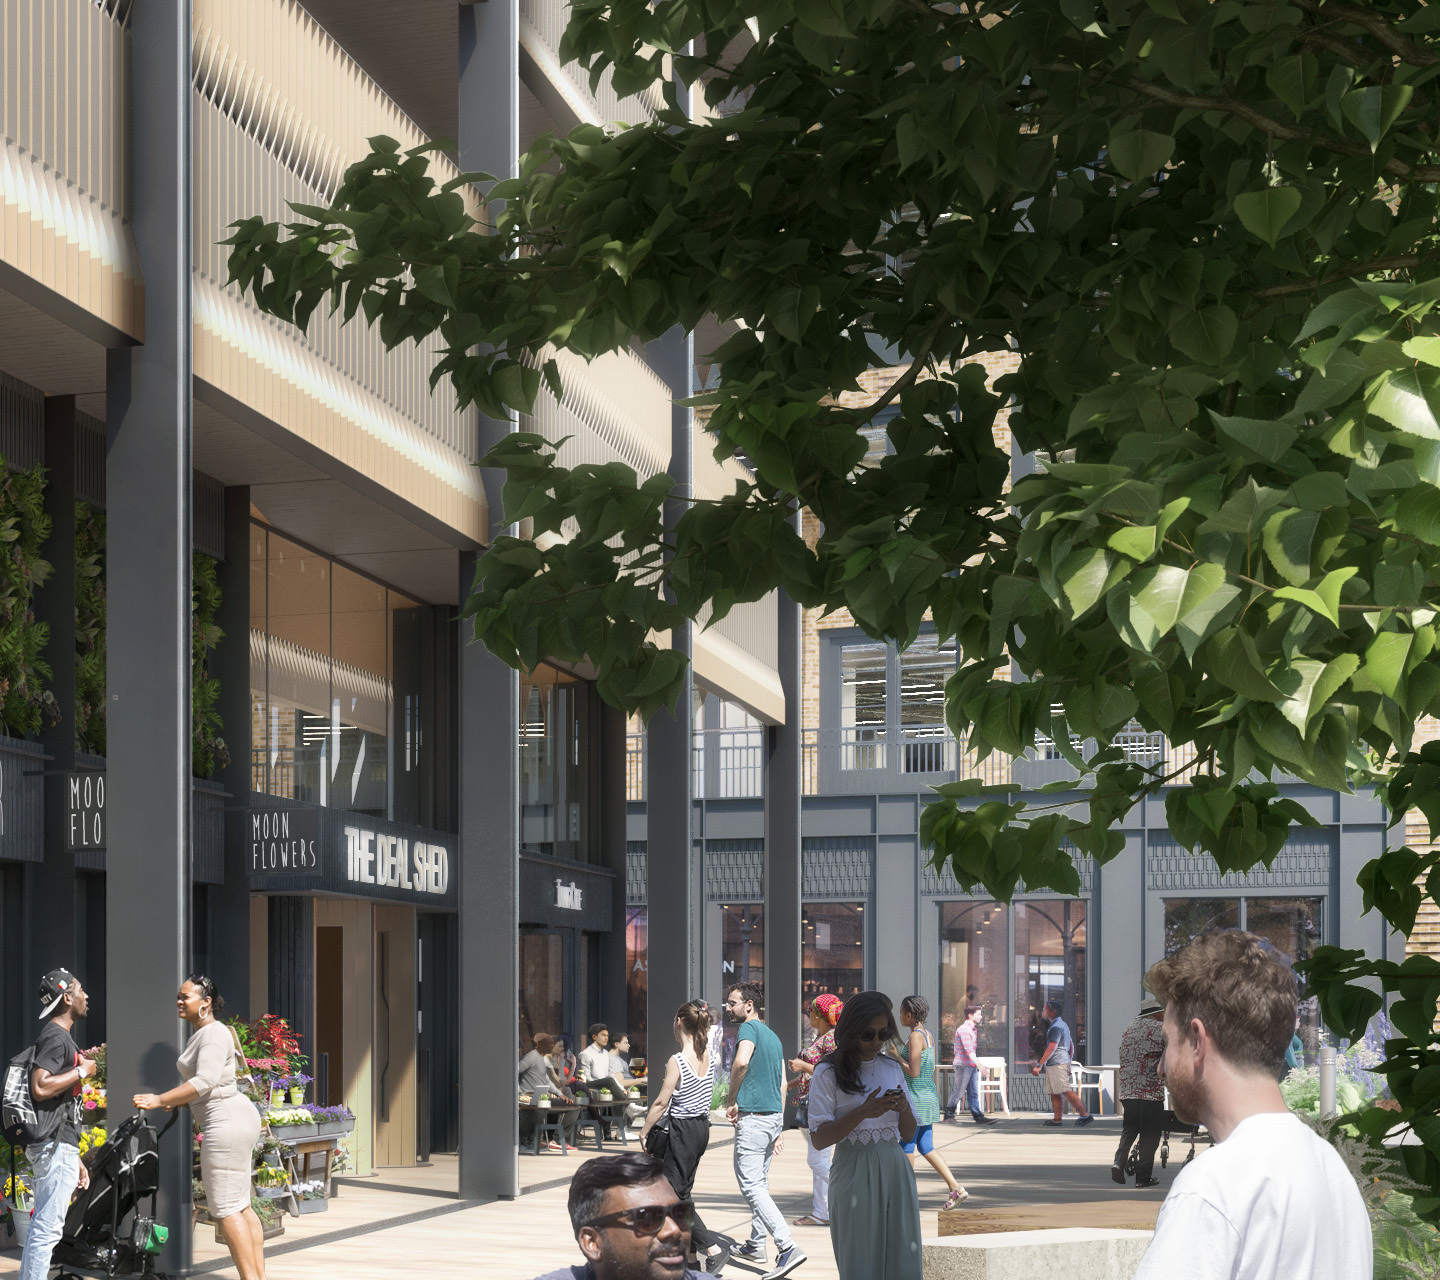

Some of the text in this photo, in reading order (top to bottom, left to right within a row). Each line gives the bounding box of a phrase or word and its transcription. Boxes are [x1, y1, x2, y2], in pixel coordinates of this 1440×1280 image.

[70, 776, 106, 810] MOO
[252, 812, 289, 841] MOON
[253, 838, 316, 870] FLOWERS
[344, 825, 449, 895] THE DEAL SHED
